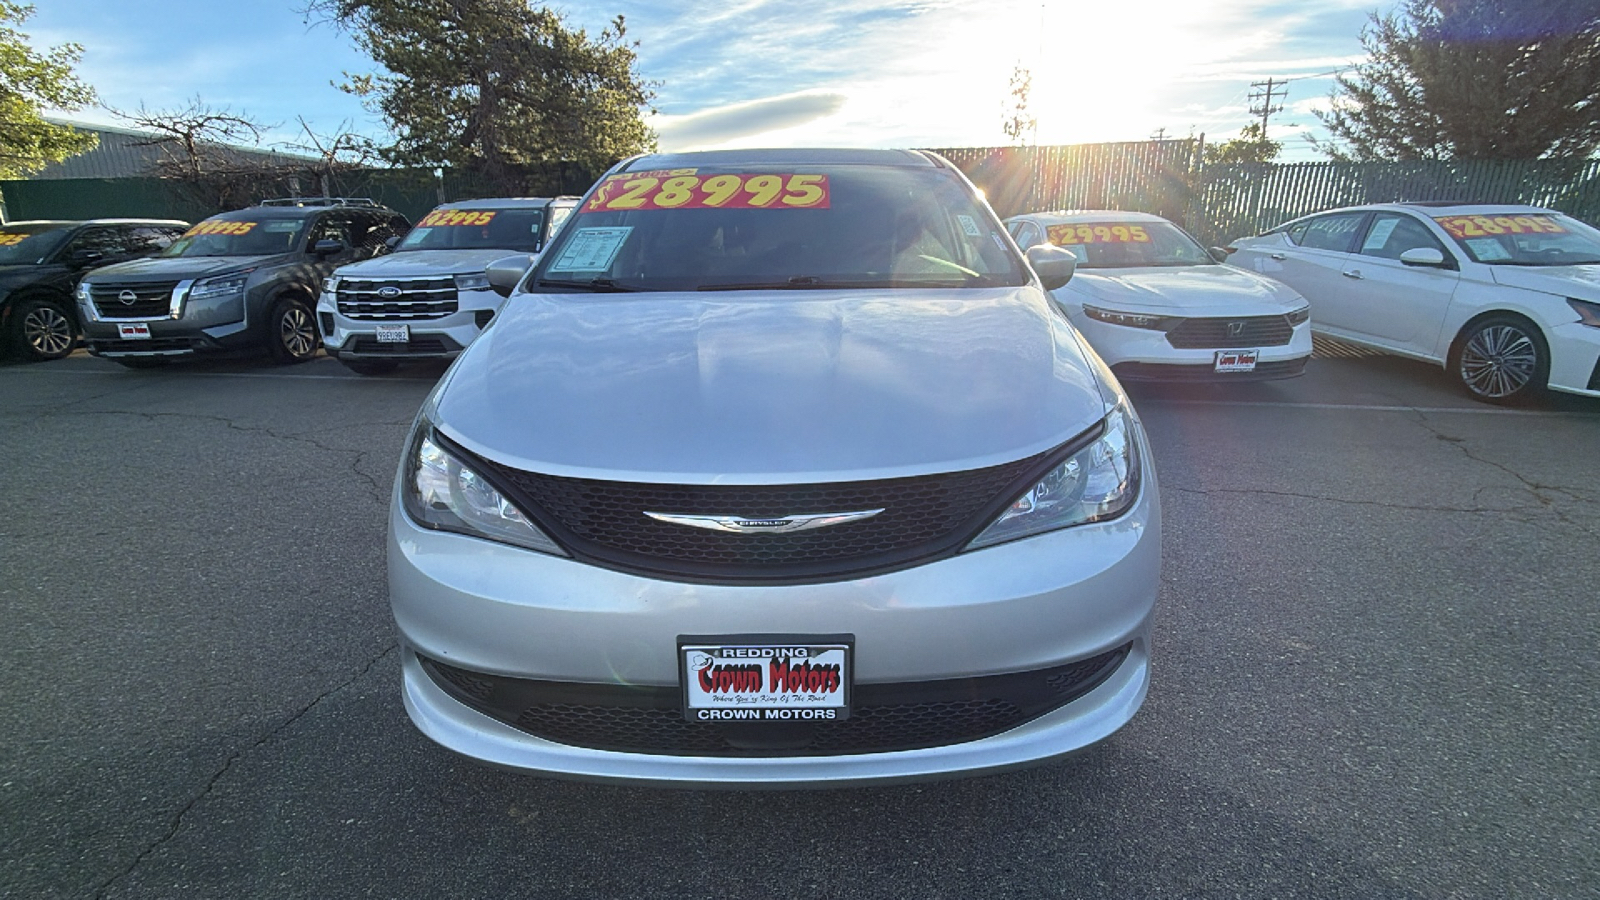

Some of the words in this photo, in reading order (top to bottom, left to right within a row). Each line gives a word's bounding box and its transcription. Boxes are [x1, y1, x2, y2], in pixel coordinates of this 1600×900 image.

[589, 175, 826, 209] $28995
[723, 648, 808, 658] REDDING
[698, 659, 763, 693] Crown
[769, 657, 840, 694] Motors
[712, 694, 733, 702] Where
[760, 694, 778, 704] King
[780, 694, 790, 703] Of
[792, 694, 804, 702] The
[807, 694, 827, 702] Road
[698, 709, 760, 719] CROWN
[765, 709, 836, 719] MOTORS
